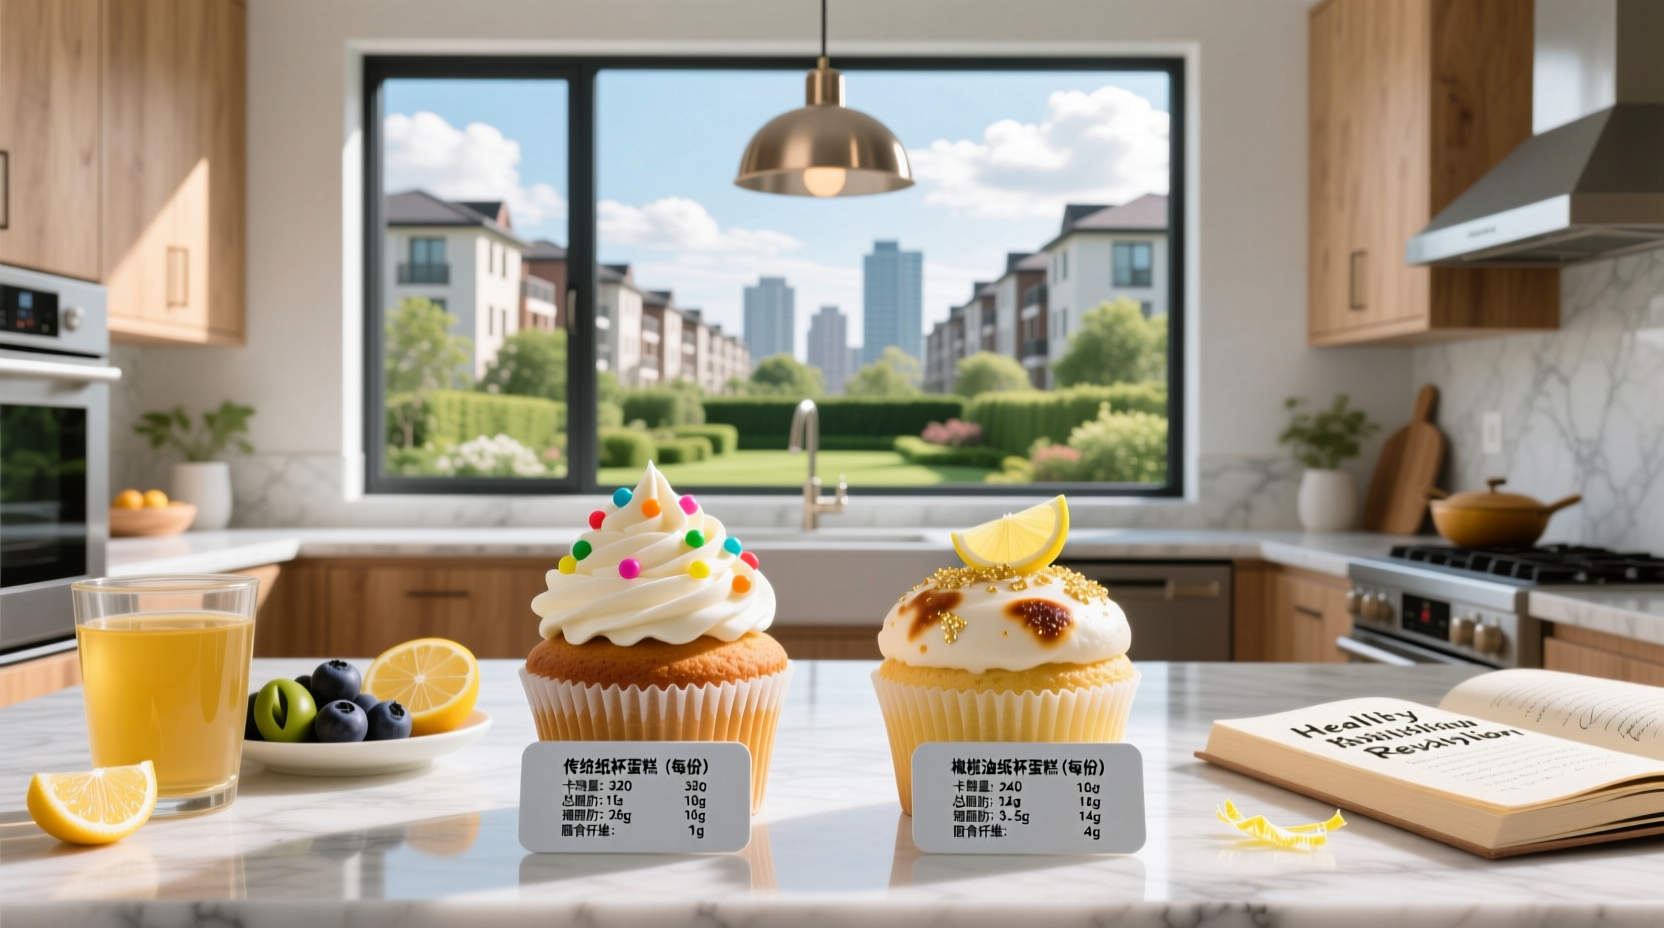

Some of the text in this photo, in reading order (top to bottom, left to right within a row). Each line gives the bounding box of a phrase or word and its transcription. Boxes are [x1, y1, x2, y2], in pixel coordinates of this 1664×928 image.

[608, 780, 633, 792] 320
[1079, 810, 1102, 825] 14g
[687, 824, 705, 839] 1g
[1083, 825, 1101, 841] 4g
